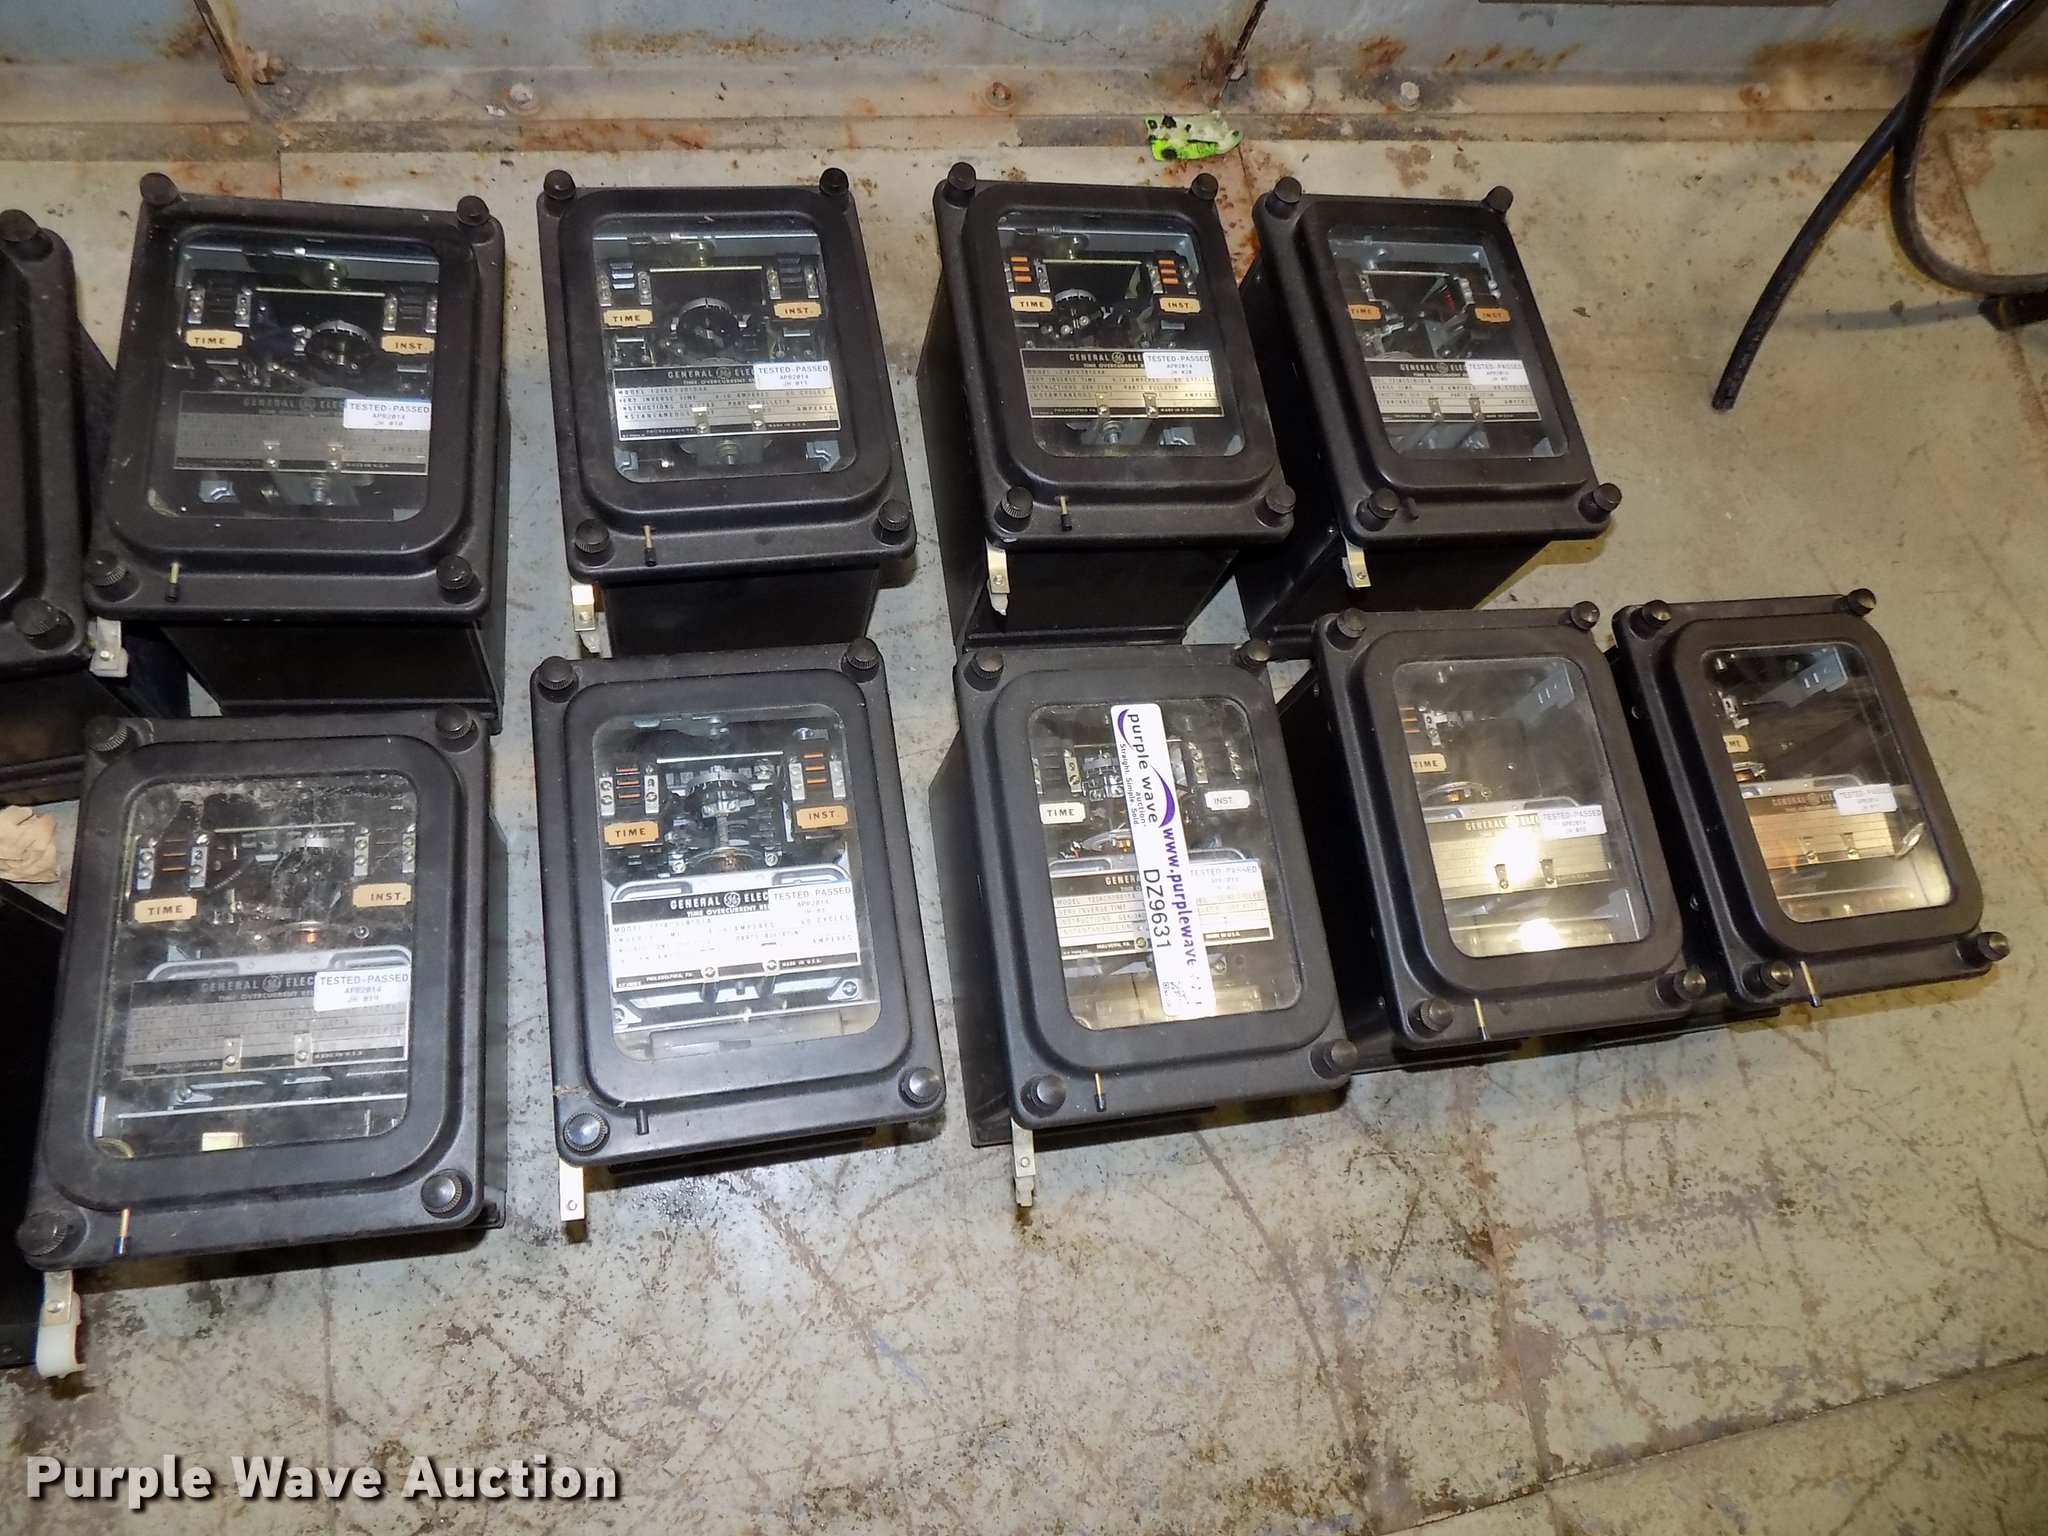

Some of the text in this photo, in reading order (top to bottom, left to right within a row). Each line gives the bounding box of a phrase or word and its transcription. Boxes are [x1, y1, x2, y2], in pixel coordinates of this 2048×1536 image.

[612, 314, 640, 322] TIME
[193, 336, 226, 345] TIME
[394, 341, 427, 351] INST.
[1069, 353, 1110, 361] GENERAL
[667, 369, 713, 379] GENERAL
[758, 365, 828, 373] TESTED-PASSED
[350, 403, 430, 413] TESTED-PASSED
[1127, 714, 1158, 823] purple wave
[1413, 760, 1438, 768] TIME
[1120, 744, 1130, 776] Straight.
[1126, 778, 1135, 805] Simple.
[808, 810, 841, 820] INST.
[1047, 808, 1075, 817] TIME
[1465, 820, 1505, 831] GENERAL
[615, 828, 647, 837] TIME
[369, 891, 406, 902] INST.
[670, 896, 721, 910] GENERAL
[148, 904, 184, 916] TIME
[707, 907, 756, 915] OVERCURRENT
[1079, 905, 1107, 913] INVERSE
[1143, 869, 1172, 948] DZ9631
[320, 974, 408, 985] TESTED-PASSED
[201, 980, 259, 992] GENERAL
